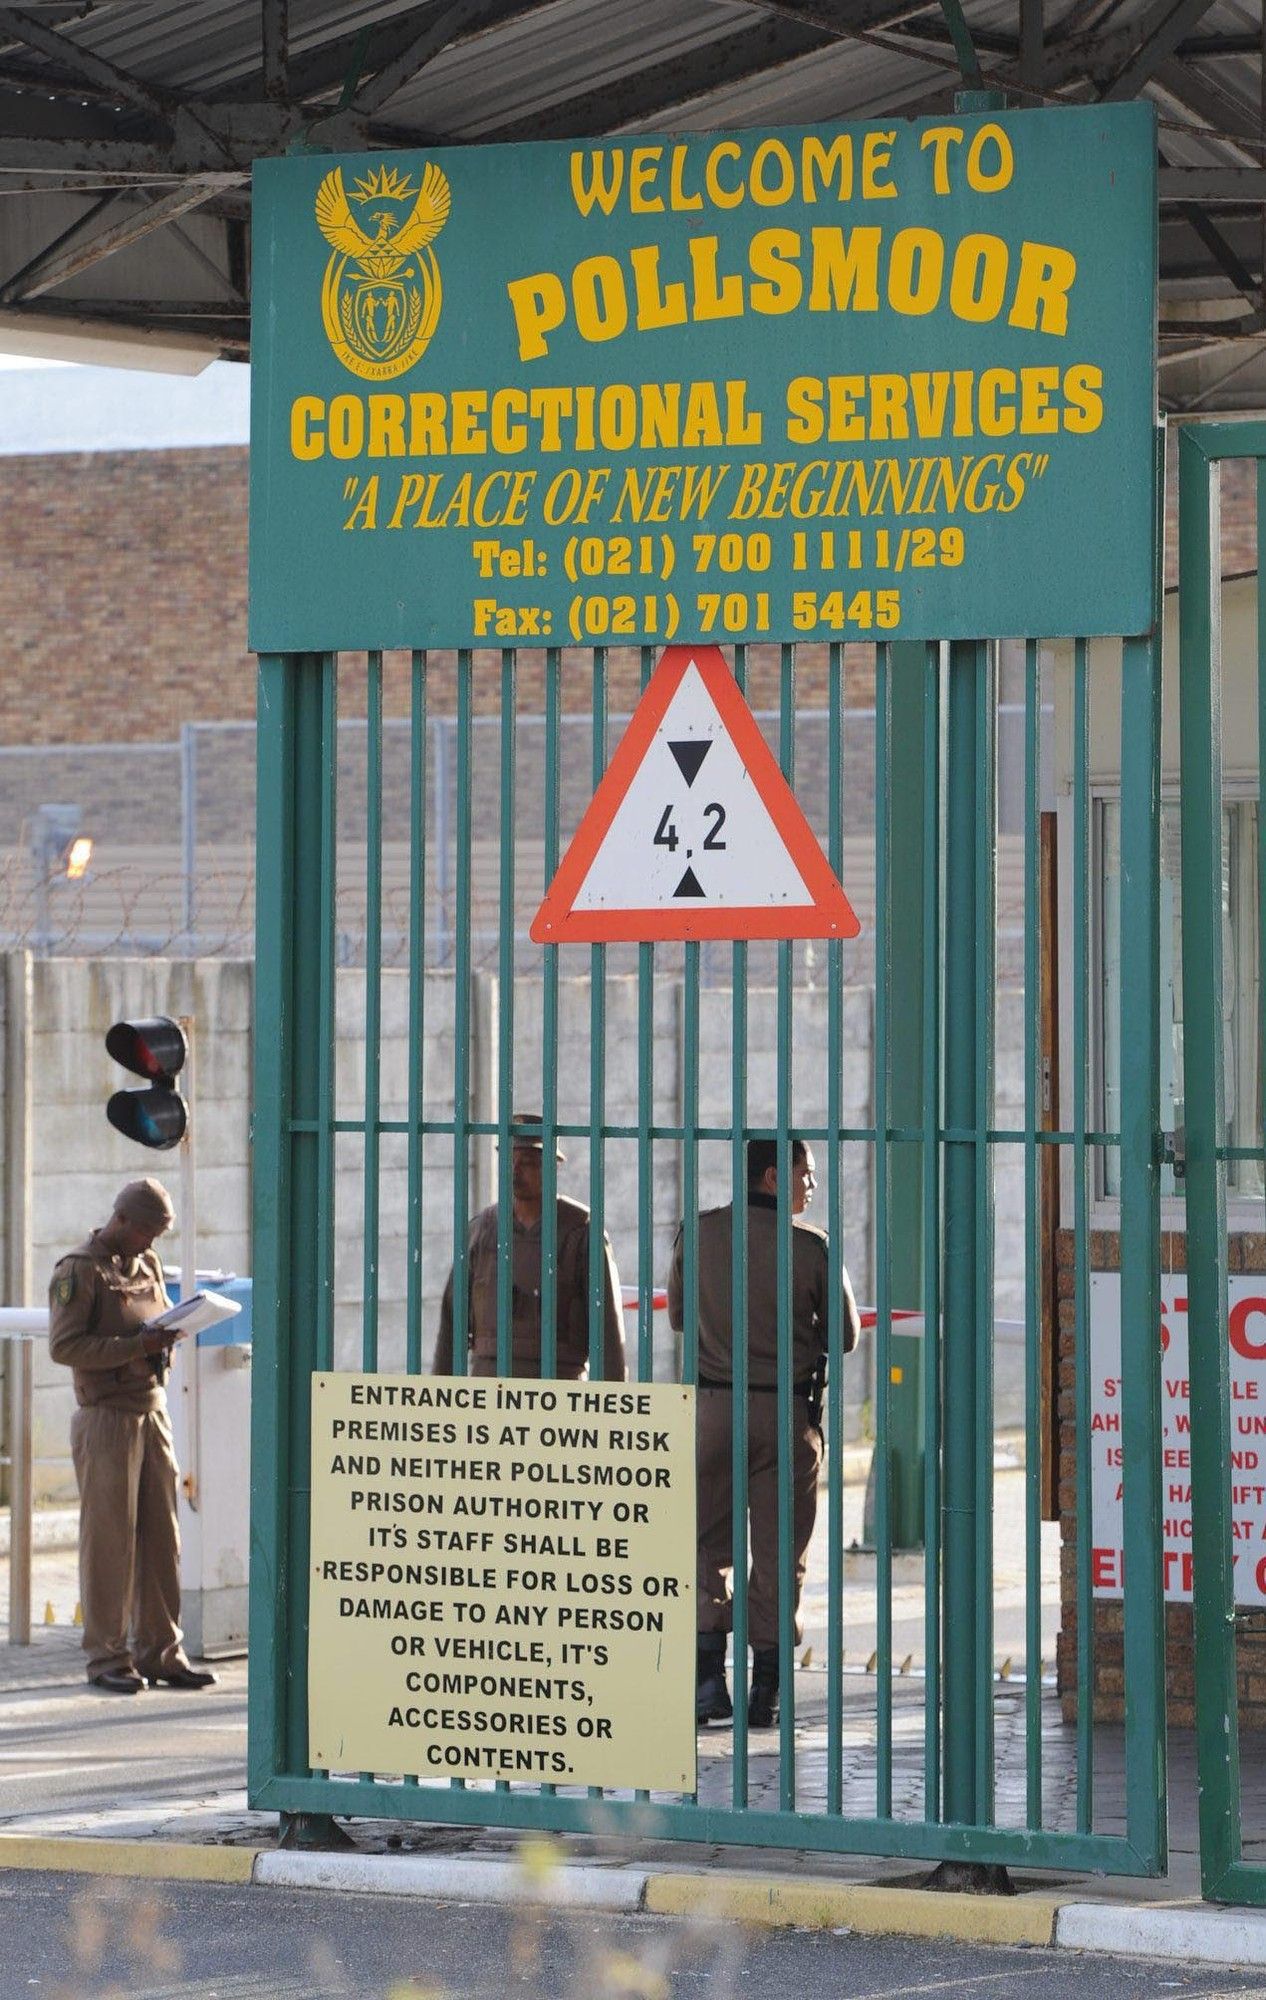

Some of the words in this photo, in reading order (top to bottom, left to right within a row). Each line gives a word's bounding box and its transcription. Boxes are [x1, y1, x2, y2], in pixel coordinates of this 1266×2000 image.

[570, 130, 897, 216] WELCOME
[920, 122, 1014, 196] TO
[507, 226, 1077, 362] POLLSMOOR
[289, 379, 763, 462] CORRECTIONAL
[786, 363, 1104, 445] SERVICES
[343, 474, 380, 530] "A
[388, 469, 538, 529] PLACE
[542, 467, 611, 526] OF
[610, 463, 730, 523] NEW
[729, 451, 1050, 520] BEGINNINGS"
[471, 538, 549, 578] Tel:
[563, 533, 676, 583] (021)
[691, 531, 772, 573] 700
[792, 526, 965, 572] 1111/29
[473, 598, 553, 638] Fax:
[568, 593, 681, 641] (021)
[696, 591, 770, 632] 701
[792, 588, 901, 631] 5445
[653, 802, 727, 859] 4,2
[351, 1384, 487, 1410] ENTRANCE
[496, 1389, 557, 1411] INTO
[566, 1392, 651, 1415] THESE
[1165, 1380, 1258, 1400] VELE
[332, 1419, 457, 1444] PREMISES
[467, 1424, 490, 1445] IS
[499, 1426, 531, 1446] AT
[539, 1427, 599, 1449] OWN
[609, 1430, 670, 1452] RISK
[330, 1454, 381, 1476] AND
[391, 1457, 501, 1481] NEITHER
[511, 1462, 671, 1489] POLLSMOOR
[1230, 1450, 1259, 1470] ND
[351, 1491, 444, 1514] PRISON
[453, 1495, 604, 1521] AUTHORITY
[613, 1502, 649, 1524] OR
[417, 1529, 494, 1552] STAFF
[503, 1533, 586, 1557] SHALL
[596, 1537, 629, 1559] BE
[323, 1560, 497, 1589] RESPONSIBLE
[506, 1569, 557, 1592] FOR
[566, 1572, 633, 1596] LOSS
[642, 1576, 679, 1598] OR
[339, 1597, 444, 1622] DAMAGE
[452, 1602, 486, 1624] TO
[494, 1604, 548, 1627] ANY
[558, 1607, 664, 1633] PERSON
[390, 1635, 426, 1657] OR
[434, 1637, 552, 1668] VEHICLE,
[562, 1643, 609, 1666] IT'S
[405, 1671, 593, 1707] COMPONENTS,
[388, 1707, 567, 1737] ACCESSORIES
[576, 1717, 613, 1739] OR
[426, 1744, 574, 1773] CONTENTS.
